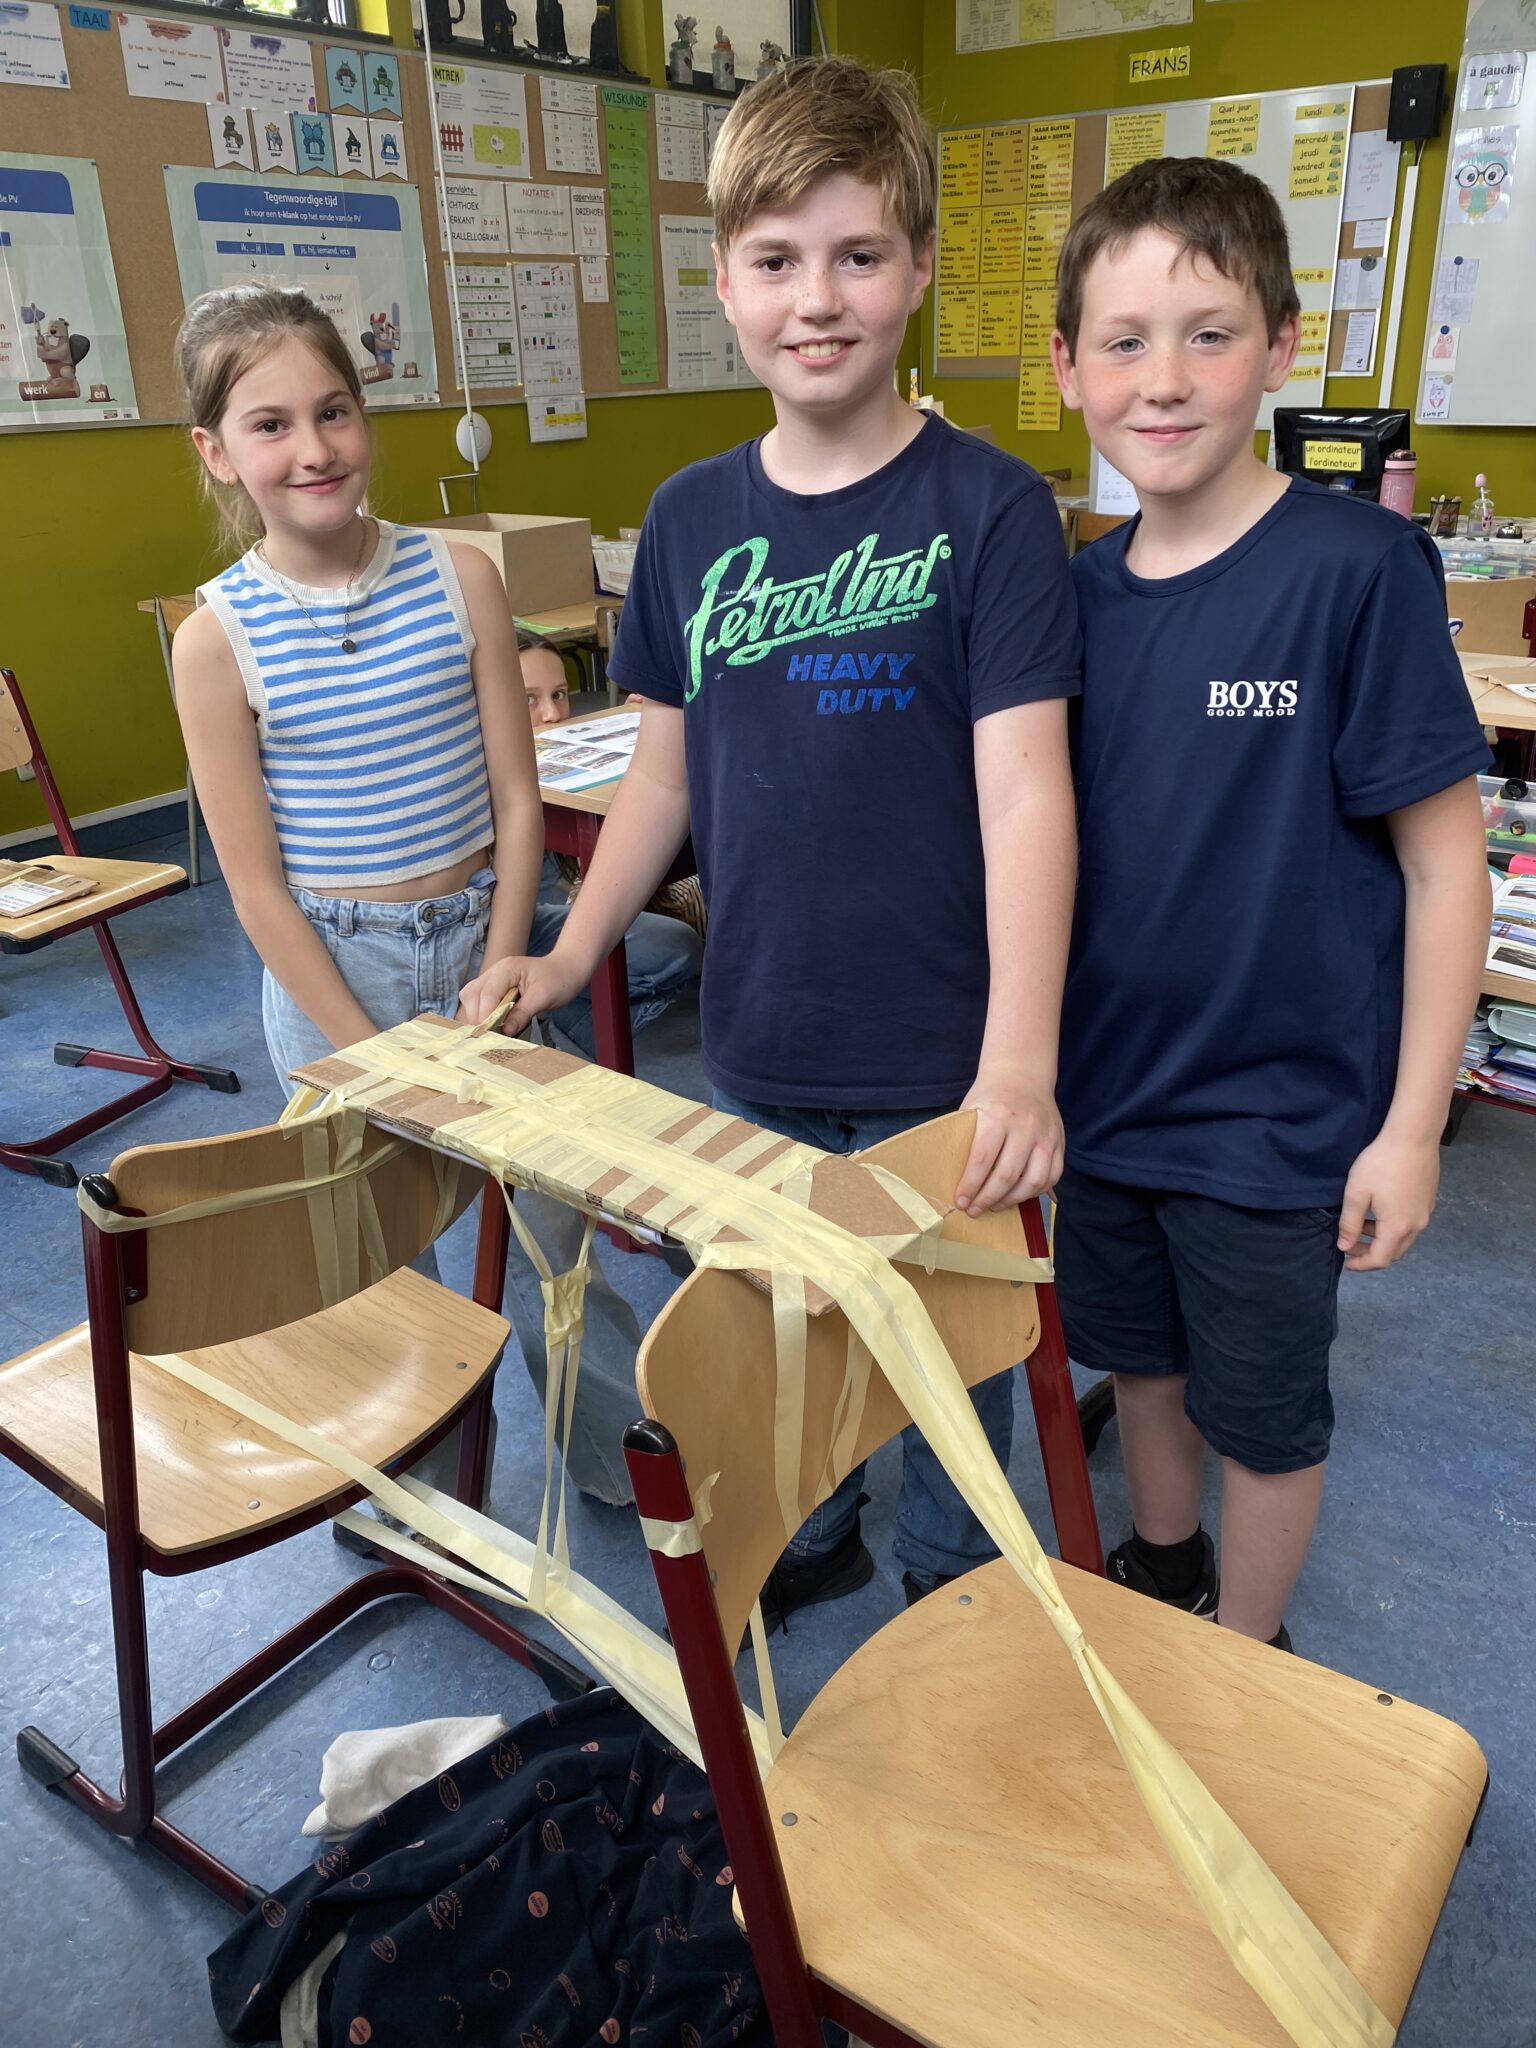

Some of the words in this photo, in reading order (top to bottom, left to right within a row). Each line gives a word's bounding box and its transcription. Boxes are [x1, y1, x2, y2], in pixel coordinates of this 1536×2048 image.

[72, 10, 107, 28] TAAL
[1132, 55, 1187, 78] FRANS
[1470, 66, 1477, 77] à
[1480, 64, 1521, 78] gauche
[433, 69, 459, 81] MTREK
[604, 90, 647, 108] WISKUNDE
[1219, 104, 1234, 113] Quel
[1237, 105, 1251, 113] jour
[1305, 108, 1322, 116] lundi
[1295, 135, 1328, 144] mercredi
[1216, 146, 1236, 155] mardi
[1300, 149, 1319, 159] jeudi
[1293, 163, 1325, 171] vendredi
[1294, 176, 1320, 184] samedi
[1290, 189, 1324, 198] dimanche
[264, 191, 323, 207] Tegenwoordige
[325, 195, 337, 206] tijd
[441, 200, 479, 210] RCHTHOEK
[278, 211, 299, 220] t-klank
[443, 215, 475, 224] VERKANT
[444, 231, 500, 241] PRALLELLOGRAM
[364, 367, 379, 378] vind
[24, 384, 49, 395] werk
[94, 391, 105, 399] en
[1317, 444, 1361, 454] ordinateur
[1310, 457, 1357, 468] l'ordinateur
[786, 653, 916, 682] HEAVY
[1207, 680, 1298, 708] BOYS
[816, 686, 916, 716] DUTY
[1207, 709, 1246, 717] GOOD
[1253, 708, 1296, 717] MOOD
